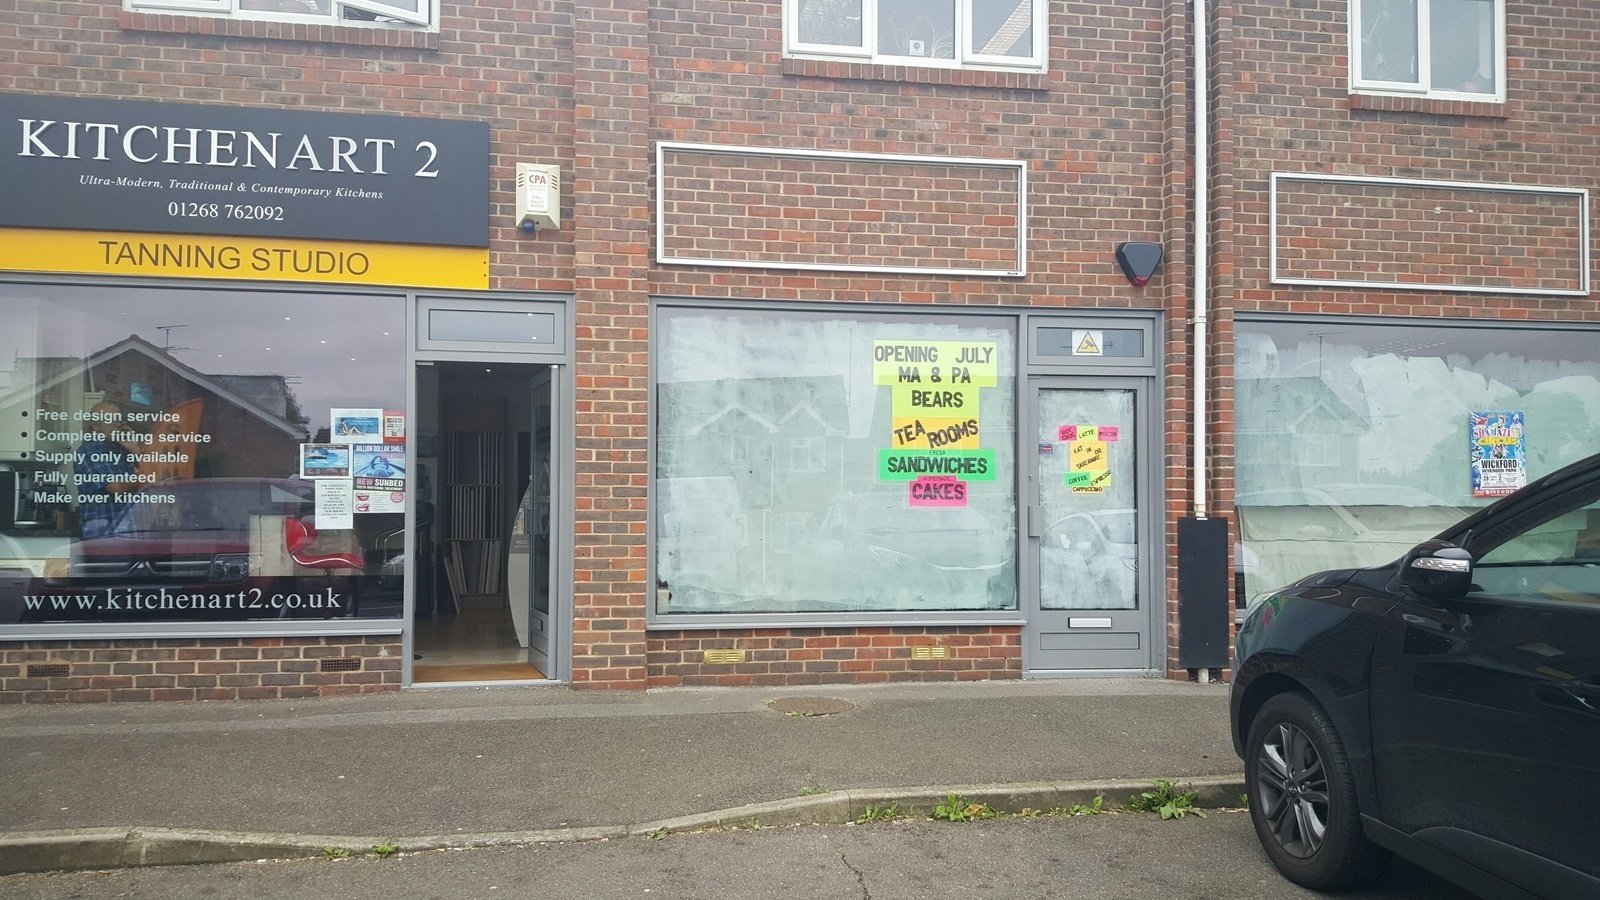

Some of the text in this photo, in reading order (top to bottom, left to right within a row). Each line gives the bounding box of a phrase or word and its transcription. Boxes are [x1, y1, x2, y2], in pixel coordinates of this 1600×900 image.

[414, 141, 440, 179] 2
[79, 174, 384, 199] Ultra-Modern, Traditional & Contemporary Kitchens
[528, 174, 547, 185] CPA
[168, 201, 285, 221] 01268 762092
[98, 240, 370, 276] TANNING STUDIO
[874, 345, 994, 364] OPENING JULY
[898, 366, 972, 384] MA & PA
[911, 389, 964, 408] BEARS
[36, 408, 181, 424] Free design service
[36, 429, 211, 445] Complete fitting service
[893, 418, 979, 449] TEA ROOMS
[1078, 428, 1095, 439] LATTE
[35, 450, 189, 465] Supply only available
[1073, 444, 1084, 454] EAT
[1094, 447, 1102, 455] OR
[887, 456, 988, 475] SANDWICHES
[1481, 459, 1518, 469] WICKFORD
[34, 470, 156, 485] Fully guaranteed
[356, 477, 373, 486] NEW
[374, 478, 404, 487] SUNBED
[1068, 475, 1088, 485] COFFEE
[34, 491, 176, 504] Make over kitchens
[911, 482, 965, 500] CAKES
[22, 587, 342, 611] www.kitchenart2.co.uk
